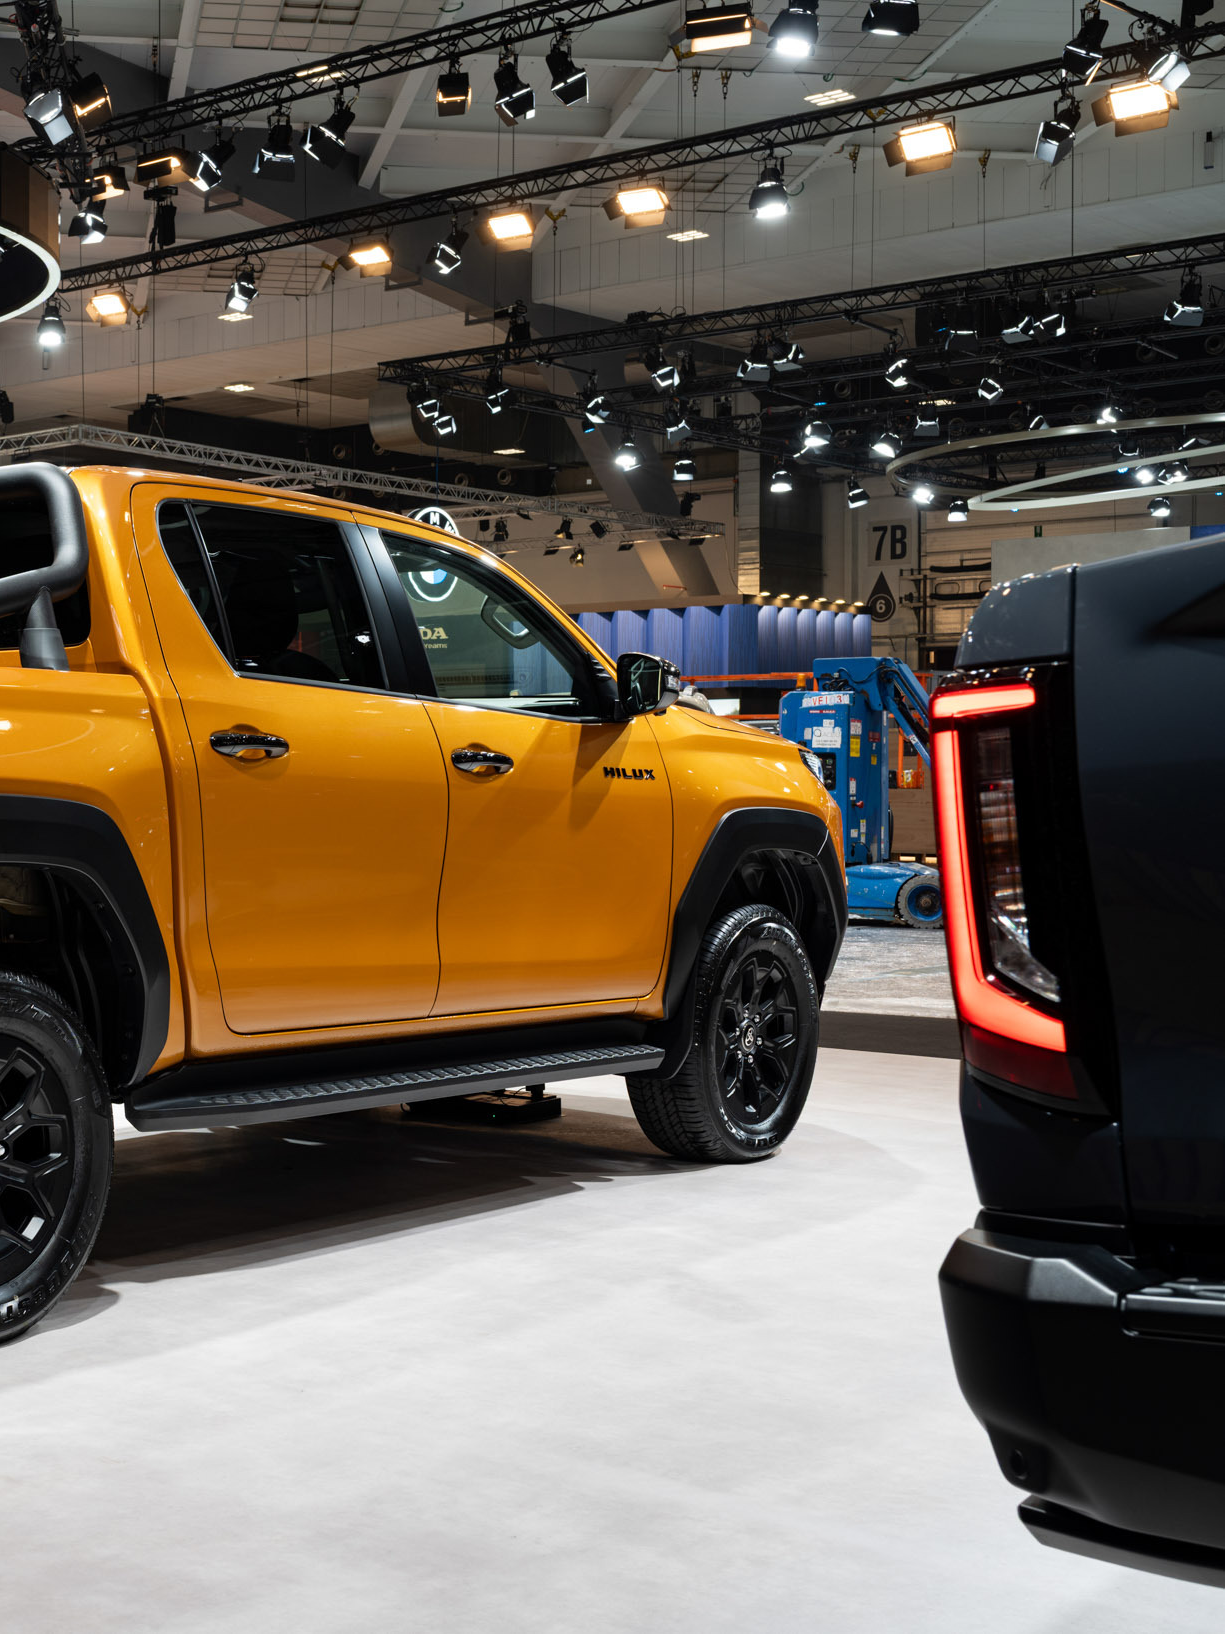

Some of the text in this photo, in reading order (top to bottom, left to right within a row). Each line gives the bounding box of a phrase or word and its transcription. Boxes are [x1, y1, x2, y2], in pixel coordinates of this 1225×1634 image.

[872, 525, 907, 561] 7B
[876, 600, 886, 613] 6
[603, 766, 655, 780] HILUX
